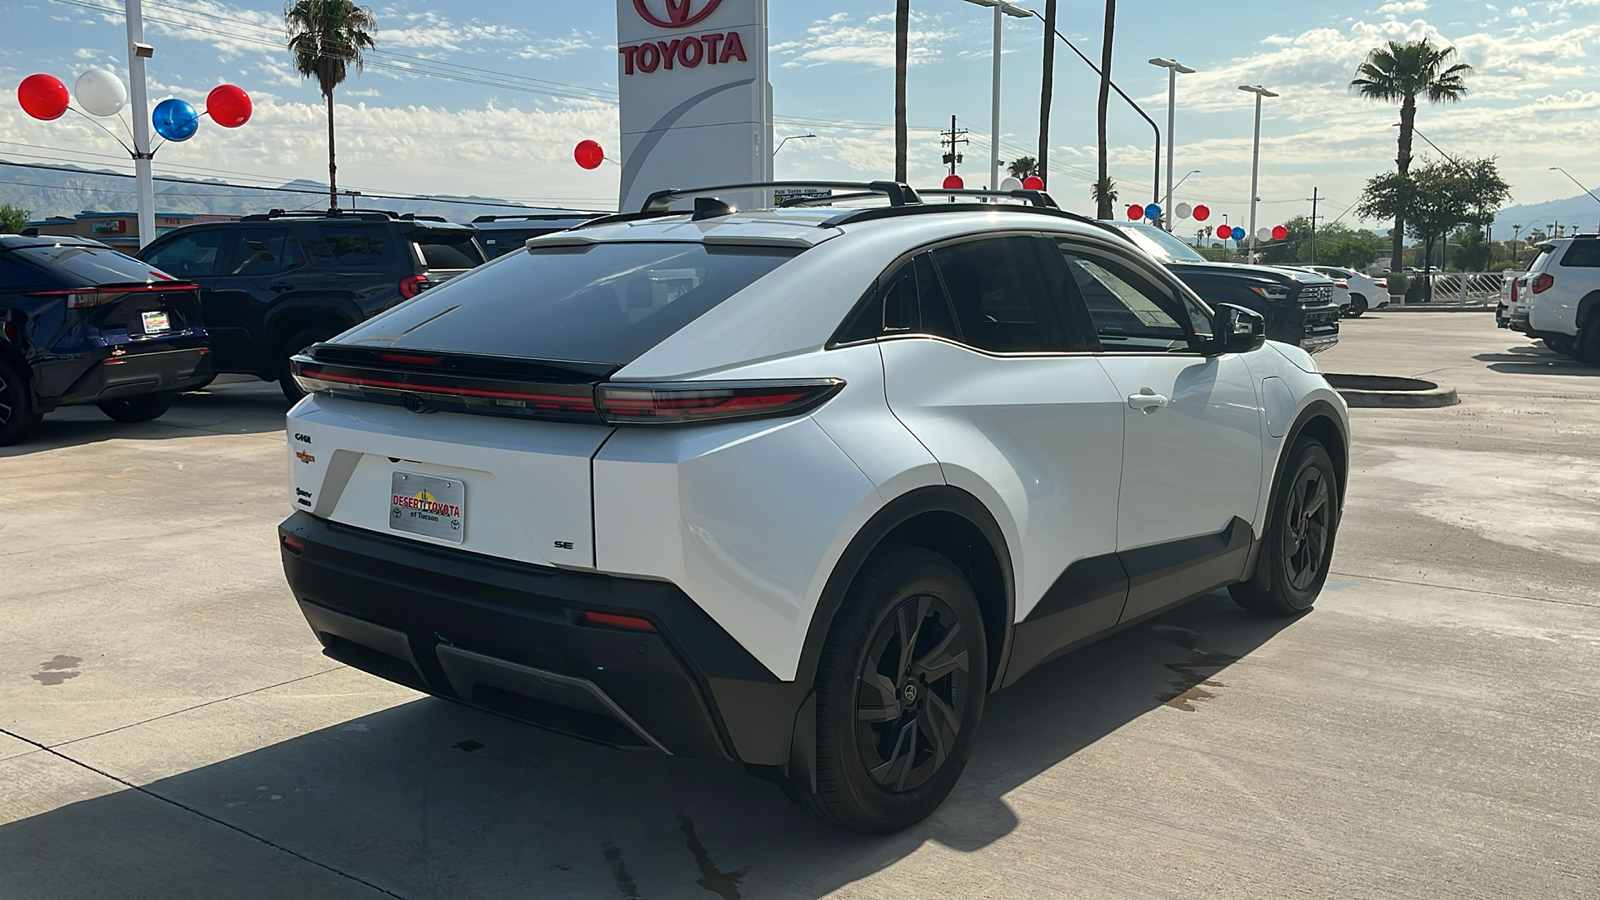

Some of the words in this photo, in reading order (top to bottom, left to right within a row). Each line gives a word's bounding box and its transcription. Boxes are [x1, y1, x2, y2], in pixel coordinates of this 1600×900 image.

[619, 32, 747, 75] TOYOTA
[393, 495, 424, 510] DESERT
[427, 501, 460, 517] TOYOTA
[418, 512, 439, 522] Tucson
[554, 541, 574, 549] SE
